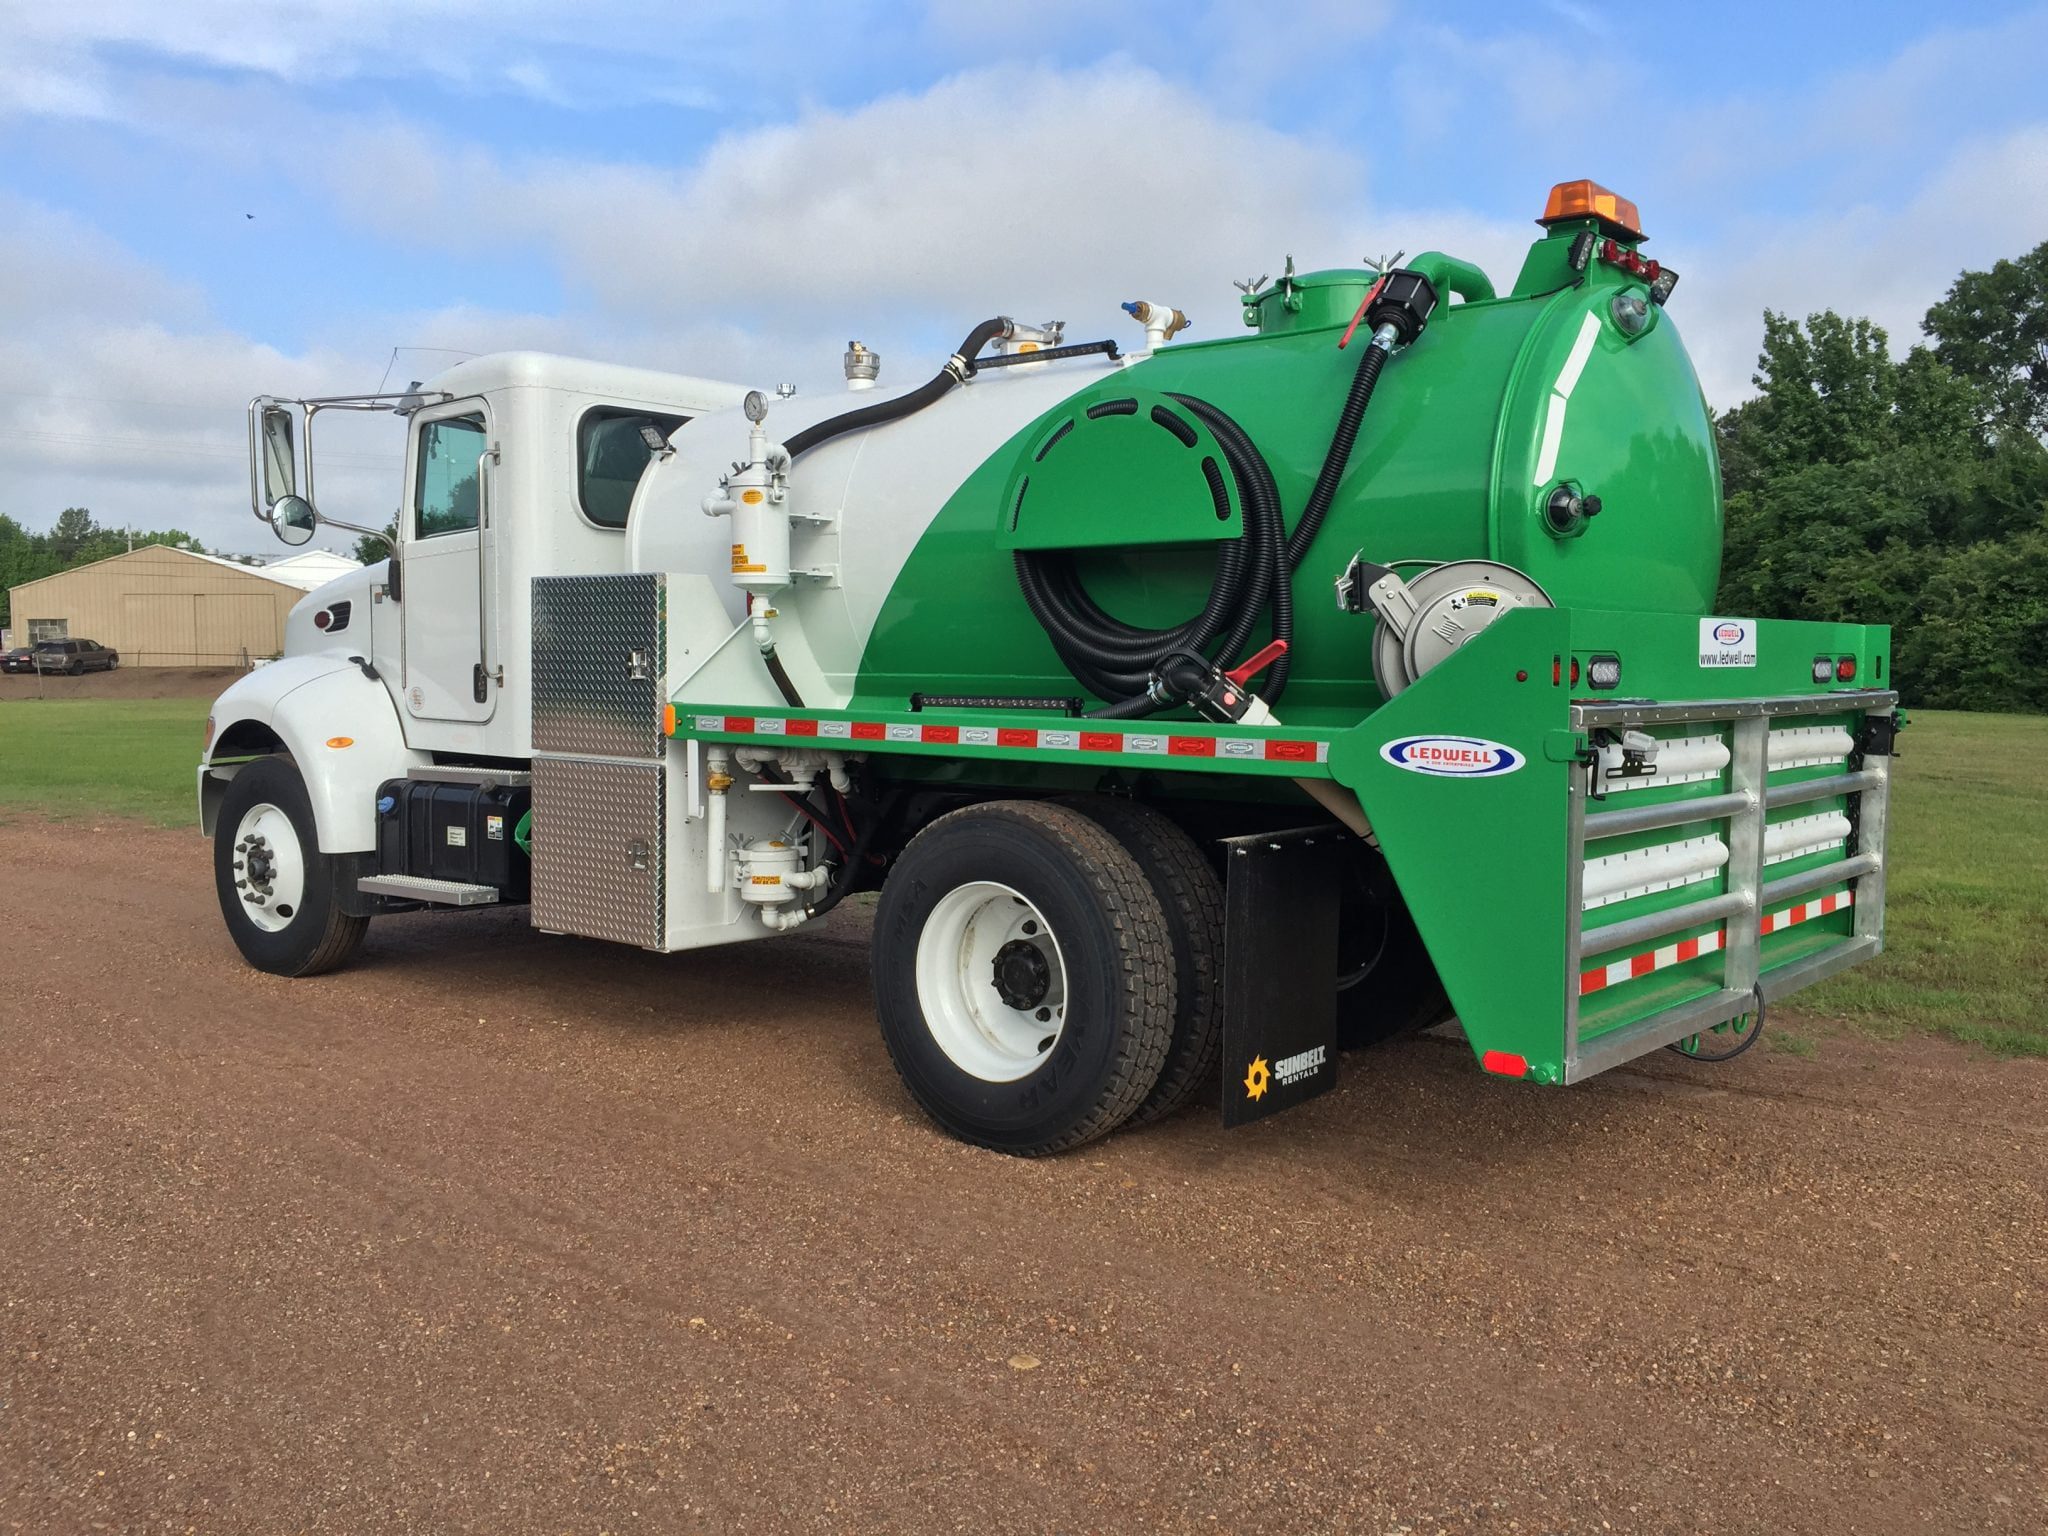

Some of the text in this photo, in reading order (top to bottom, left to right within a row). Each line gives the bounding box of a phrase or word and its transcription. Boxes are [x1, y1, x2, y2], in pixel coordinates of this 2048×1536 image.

[1718, 629, 1739, 638] LEDWELL
[1700, 650, 1756, 665] www.ledwell.com
[1410, 746, 1491, 763] LEDWELL
[1282, 1066, 1319, 1086] RENTALS
